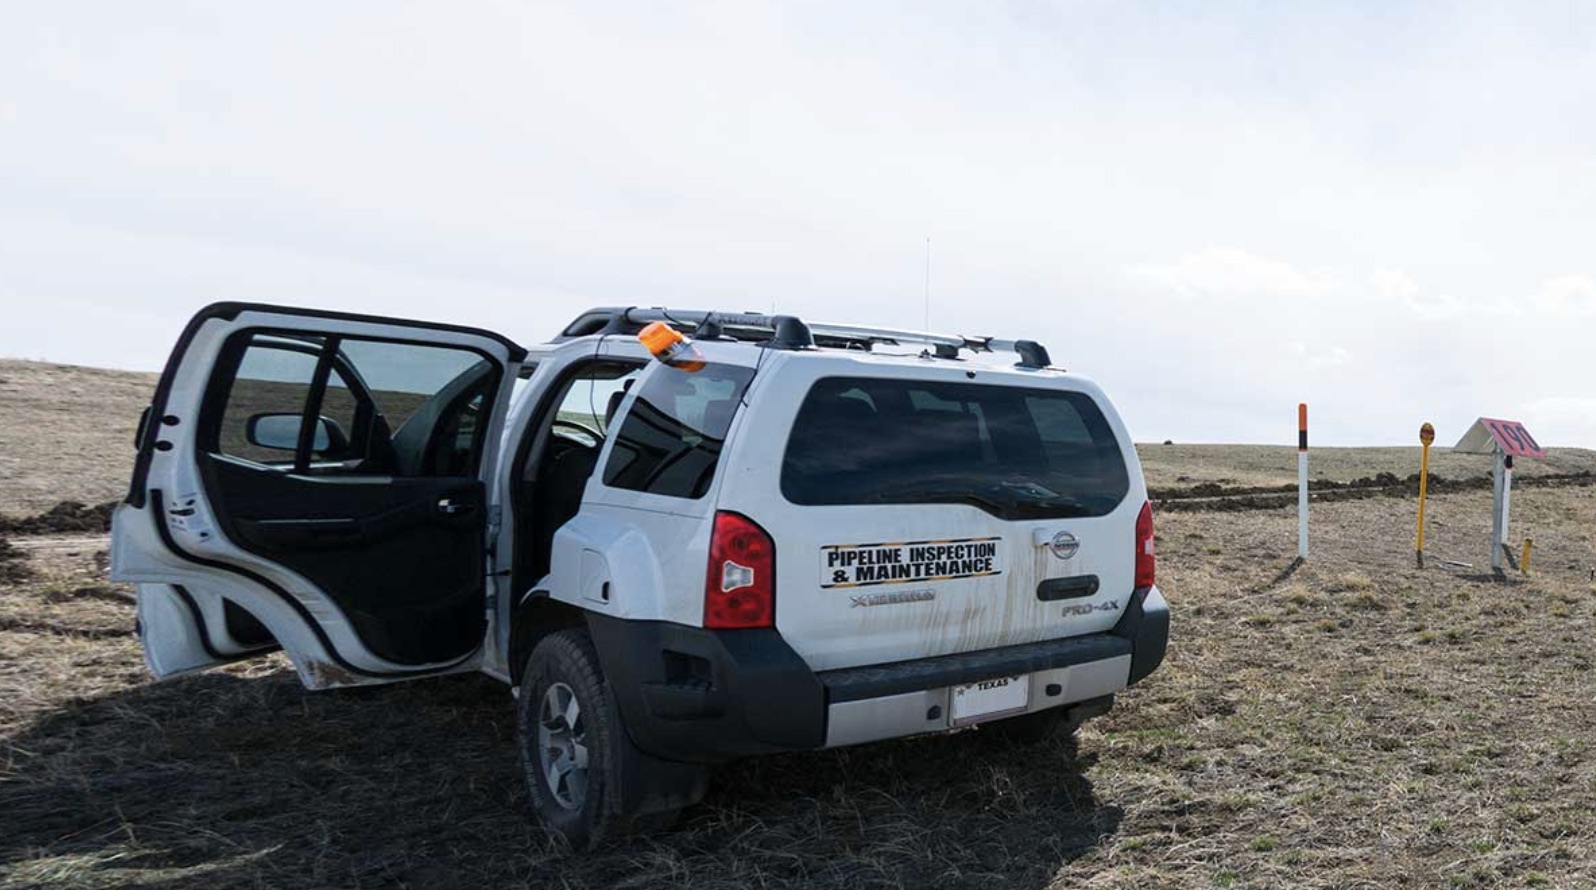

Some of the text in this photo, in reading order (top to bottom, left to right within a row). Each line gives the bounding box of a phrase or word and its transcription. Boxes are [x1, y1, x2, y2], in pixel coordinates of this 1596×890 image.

[1491, 422, 1540, 451] 190
[828, 543, 996, 567] PIPELINE INSPECTION
[832, 558, 993, 583] & MAINTENANCE
[1061, 600, 1118, 617] PRO-4X
[978, 678, 1009, 691] TEXAS
